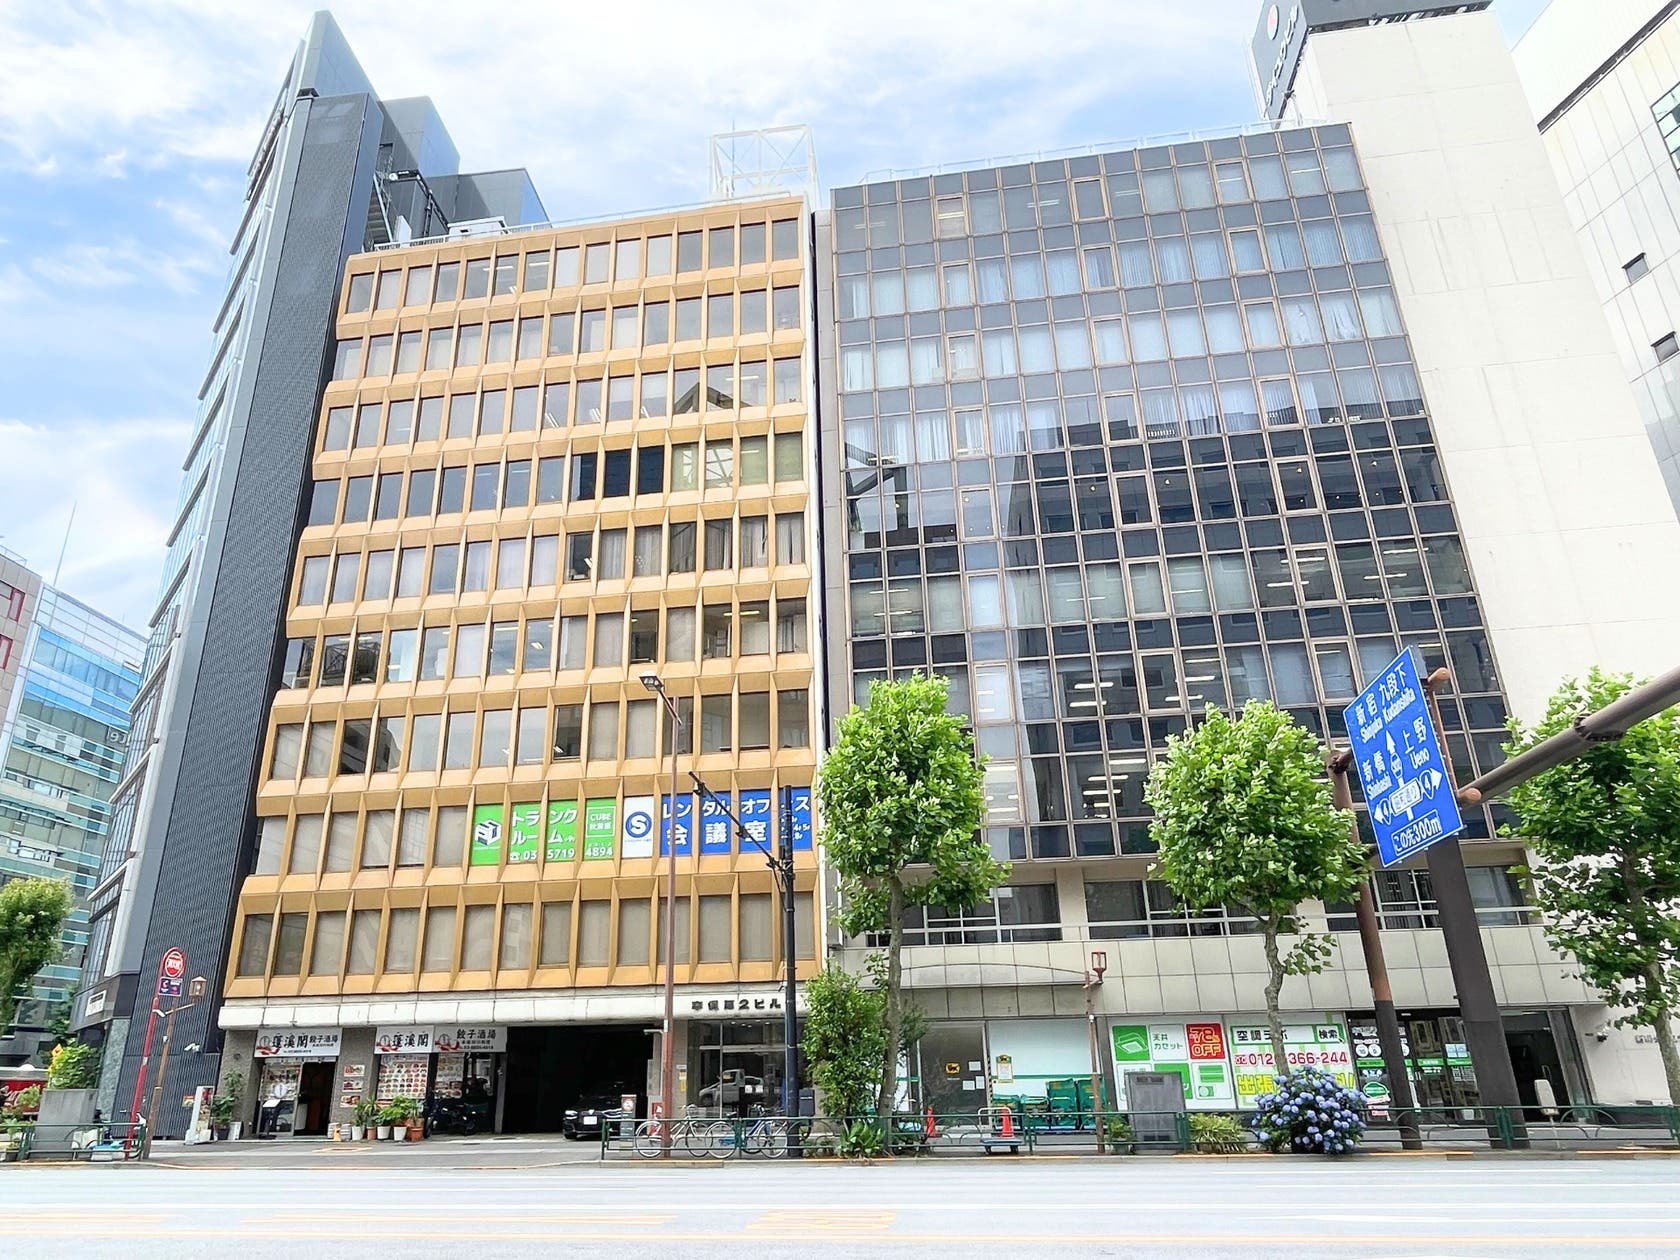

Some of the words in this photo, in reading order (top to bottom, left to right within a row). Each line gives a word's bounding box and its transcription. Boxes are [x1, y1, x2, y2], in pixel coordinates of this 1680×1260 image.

[1378, 661, 1406, 706] 九段下
[1402, 716, 1427, 754] 上野
[1409, 748, 1430, 769] Ueno
[1424, 774, 1432, 791] 4
[663, 796, 811, 819] レンタルオフス
[512, 808, 577, 827] トランク
[589, 812, 612, 822] CUBE
[511, 829, 563, 846] ルーム
[666, 821, 767, 845] 会議室
[1393, 816, 1441, 852] この先300m
[546, 848, 576, 859] 5719
[585, 846, 613, 857] 4894
[1153, 1033, 1168, 1041] 天井
[1319, 1029, 1338, 1039] 検索
[1191, 1044, 1221, 1057] OFF
[1248, 1051, 1348, 1066] 012366-244
